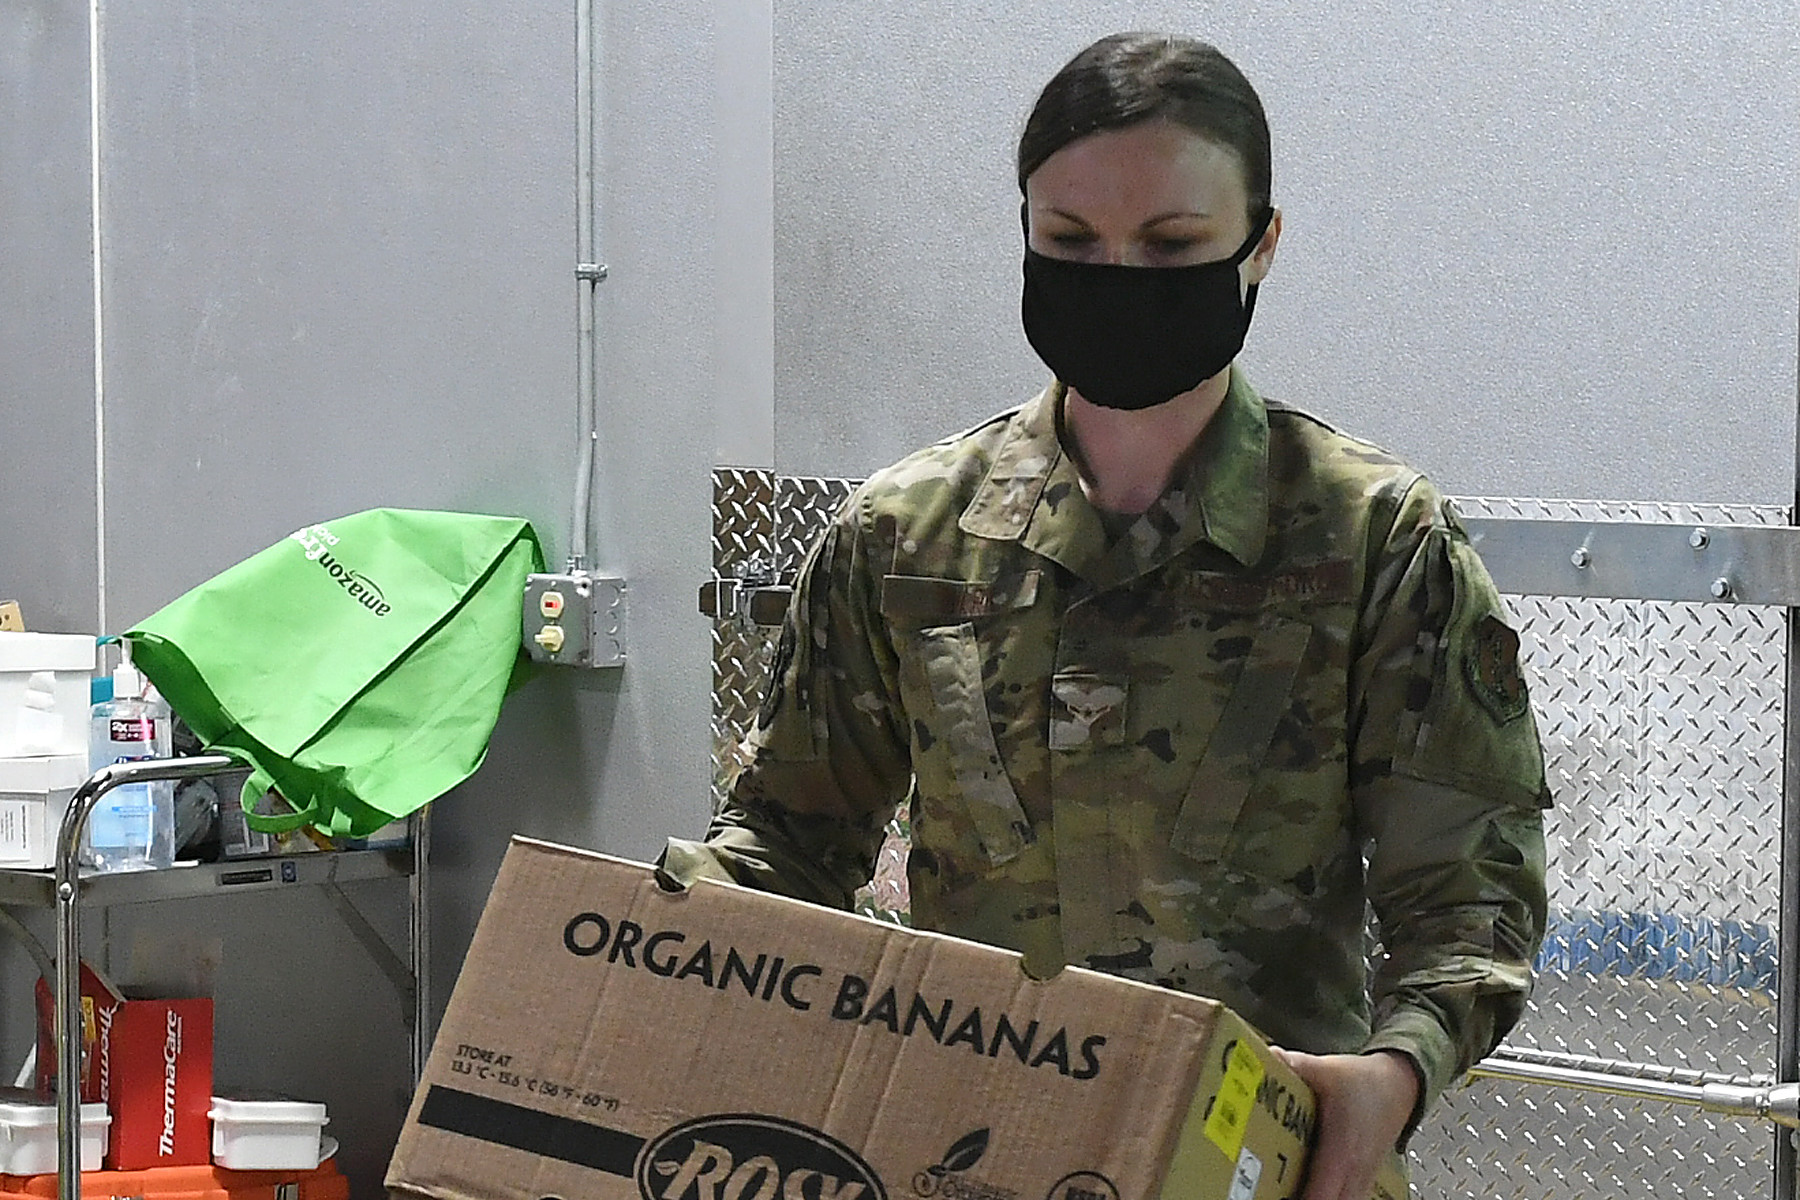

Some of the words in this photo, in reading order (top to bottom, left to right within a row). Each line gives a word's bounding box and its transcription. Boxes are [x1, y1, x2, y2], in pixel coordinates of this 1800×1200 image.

[289, 527, 391, 617] amazonfre
[455, 1044, 493, 1062] STORE
[495, 1055, 511, 1066] AT
[563, 912, 822, 1011] ORGANIC
[831, 974, 1107, 1080] BANANAS
[158, 1008, 178, 1158] ThermaCare
